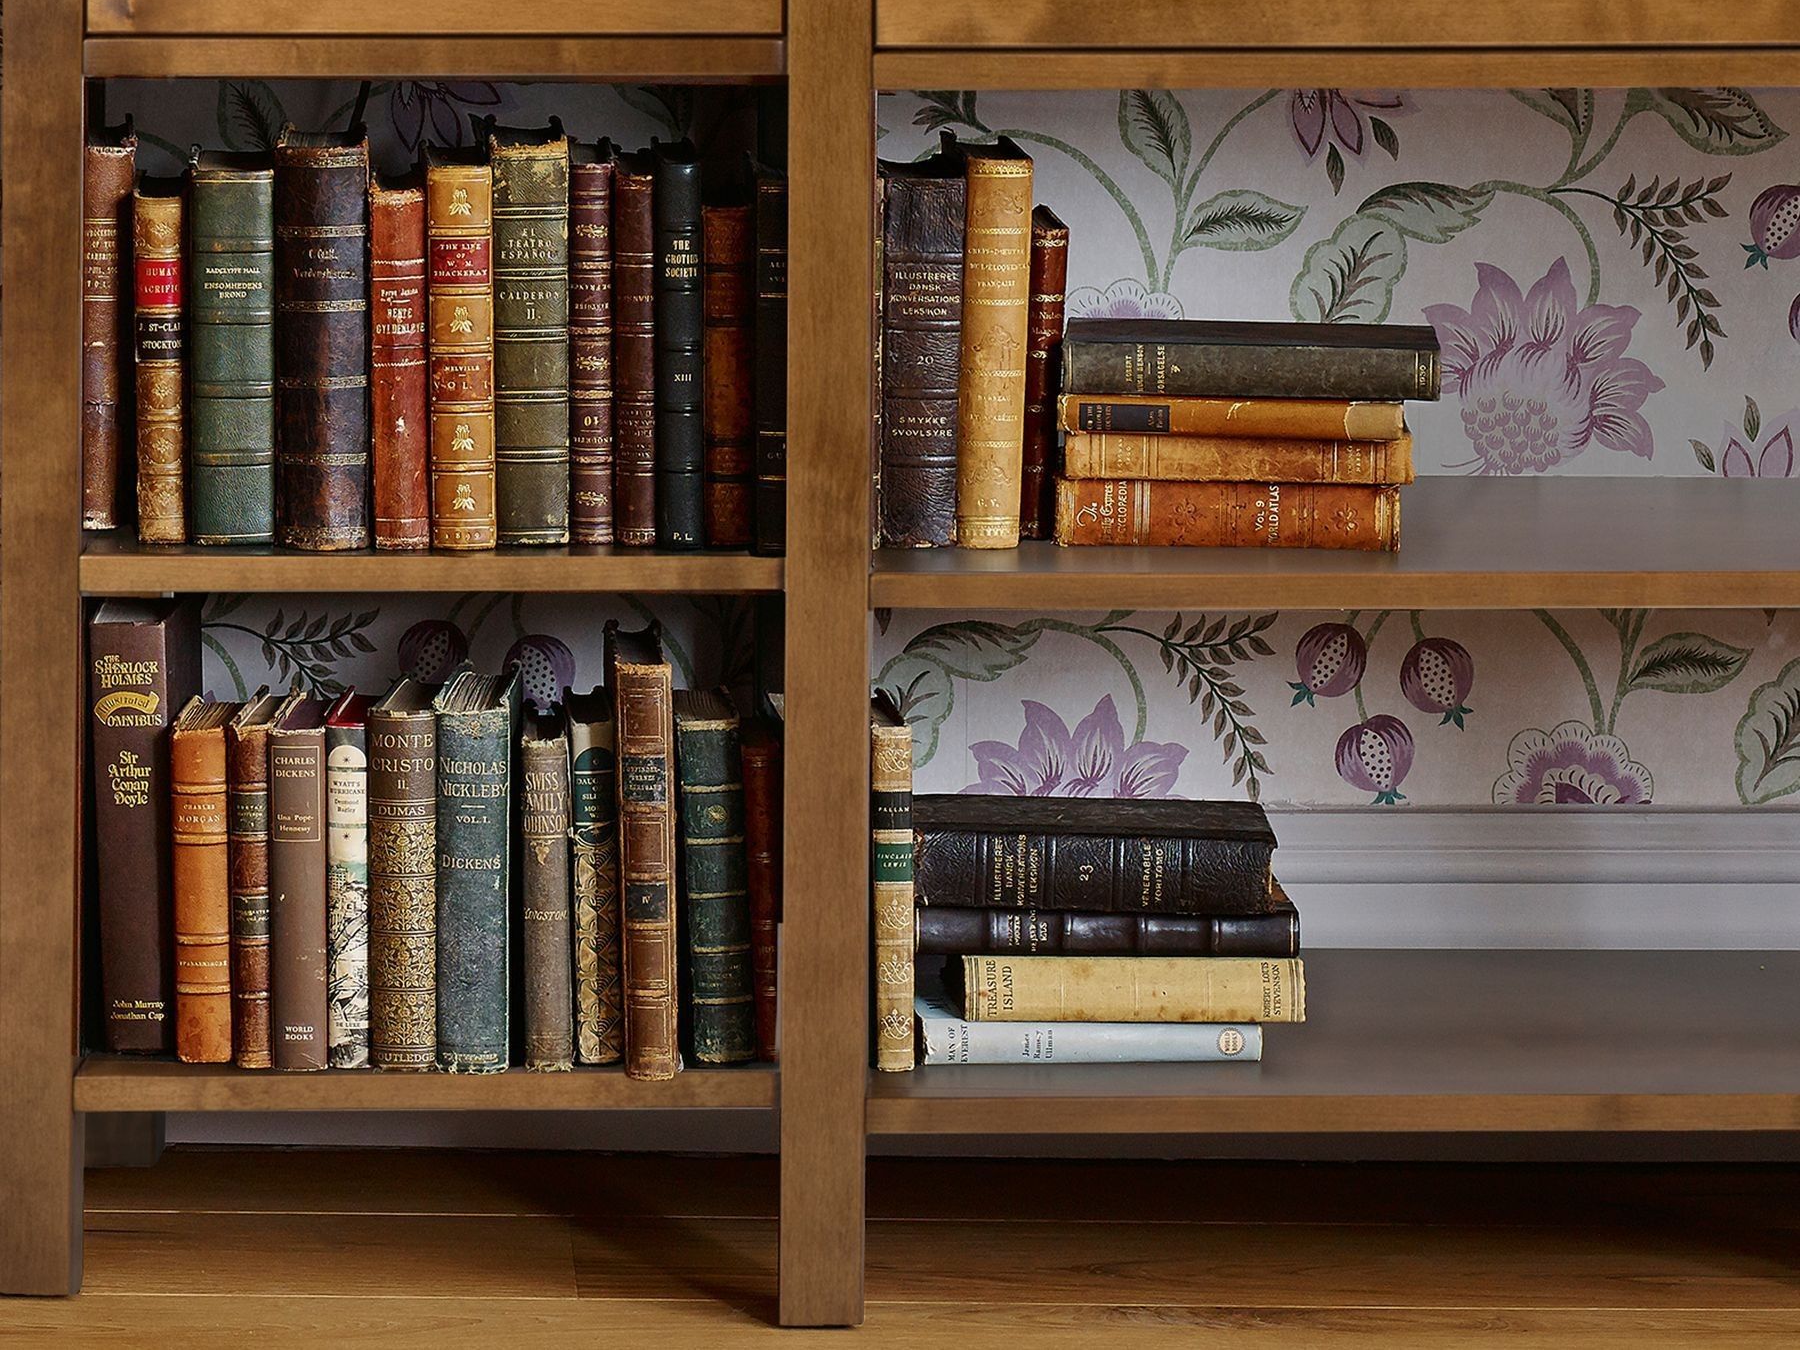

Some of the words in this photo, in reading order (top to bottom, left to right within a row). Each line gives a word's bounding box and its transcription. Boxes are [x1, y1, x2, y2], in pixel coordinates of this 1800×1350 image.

[521, 228, 536, 237] EL
[508, 239, 552, 248] TEATRO
[673, 240, 690, 250] THE
[146, 267, 178, 276] HUMAN
[204, 282, 263, 290] ENSOMHEDENS
[889, 295, 960, 303] KONVERSATIONS
[903, 308, 948, 316] LEKSIKON
[917, 355, 934, 365] 20
[674, 373, 692, 381] XIII
[892, 429, 953, 437] SVOVLSYRE
[1268, 485, 1279, 513] ATLAS
[1076, 502, 1097, 527] The
[1101, 517, 1114, 538] aily
[104, 655, 120, 663] THE
[95, 660, 158, 674] SHERLOCK
[101, 673, 153, 688] HOLMES
[107, 714, 162, 728] OMNIBUS
[371, 733, 433, 748] MONTE
[119, 750, 138, 764] Sir
[275, 756, 316, 765] CHARLES
[372, 757, 434, 772] CRISTO
[108, 763, 152, 779] Arthur
[440, 756, 507, 775] NICHOLAS
[275, 770, 316, 778] DICKENS
[525, 771, 559, 791] SWISS
[112, 778, 149, 793] Conan
[438, 779, 508, 798] NICKLEBY
[114, 792, 148, 808] Doyle
[179, 814, 220, 823] MORGAN
[294, 814, 314, 823] Pope-
[378, 806, 426, 816] DUMAS
[456, 815, 480, 823] VOL.
[523, 814, 568, 834] OBINSON
[279, 826, 311, 834] Hennessy
[442, 854, 501, 870] DICKENS
[994, 838, 1002, 900] ILLUSTRERET
[1006, 855, 1014, 888] DANSK
[1016, 834, 1027, 906] KONVERSATIONS
[1030, 848, 1038, 893] LEKSIKON
[1079, 865, 1094, 881] 23
[1142, 844, 1151, 906] VENERABILE
[1154, 849, 1163, 903] YORITOMO
[1260, 962, 1270, 983] LOUIS
[985, 960, 997, 1017] TREASURE
[1002, 965, 1013, 1010] ISLAND
[1271, 964, 1281, 1016] STEVENSON
[134, 1000, 164, 1009] Murray
[948, 1027, 955, 1039] OF
[376, 1052, 436, 1062] OUTLEDGE
